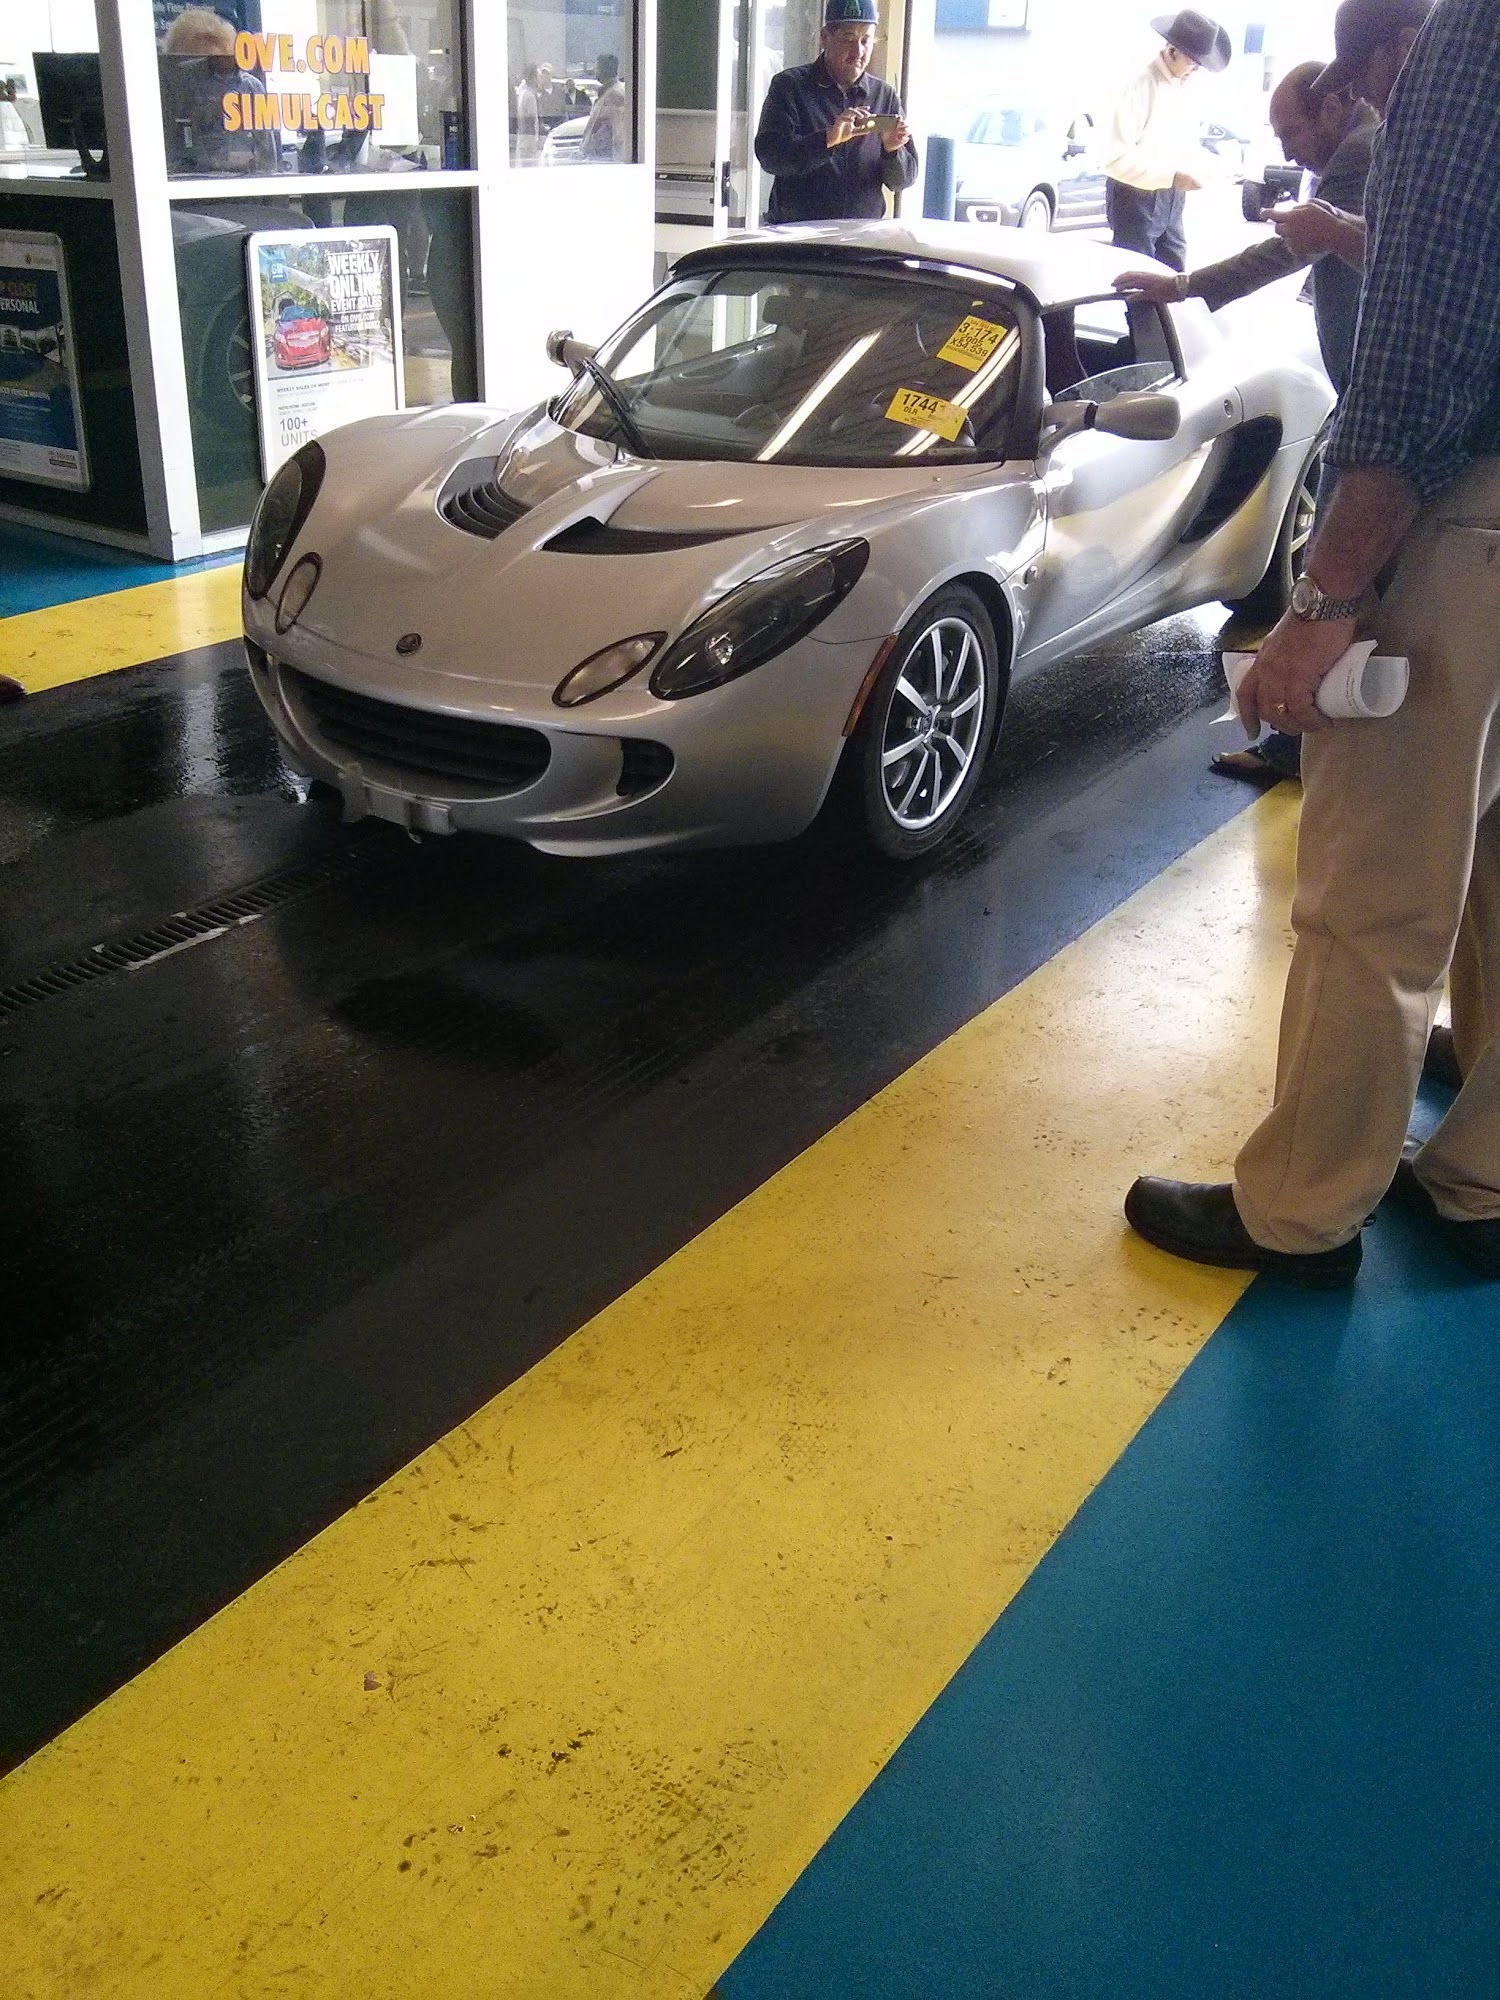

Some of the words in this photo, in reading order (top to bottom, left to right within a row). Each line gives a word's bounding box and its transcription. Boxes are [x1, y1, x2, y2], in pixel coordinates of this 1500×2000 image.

[235, 31, 370, 74] OVE.COM
[222, 92, 385, 131] SIMULCAST
[328, 252, 380, 275] WEEKLY
[329, 274, 382, 299] ONLINE
[331, 297, 356, 312] EVENT
[357, 295, 383, 310] SALES
[961, 333, 984, 347] 2005
[903, 393, 939, 414] 1744
[903, 406, 918, 416] DLR
[280, 417, 308, 431] 100+
[281, 430, 318, 447] UNITS
